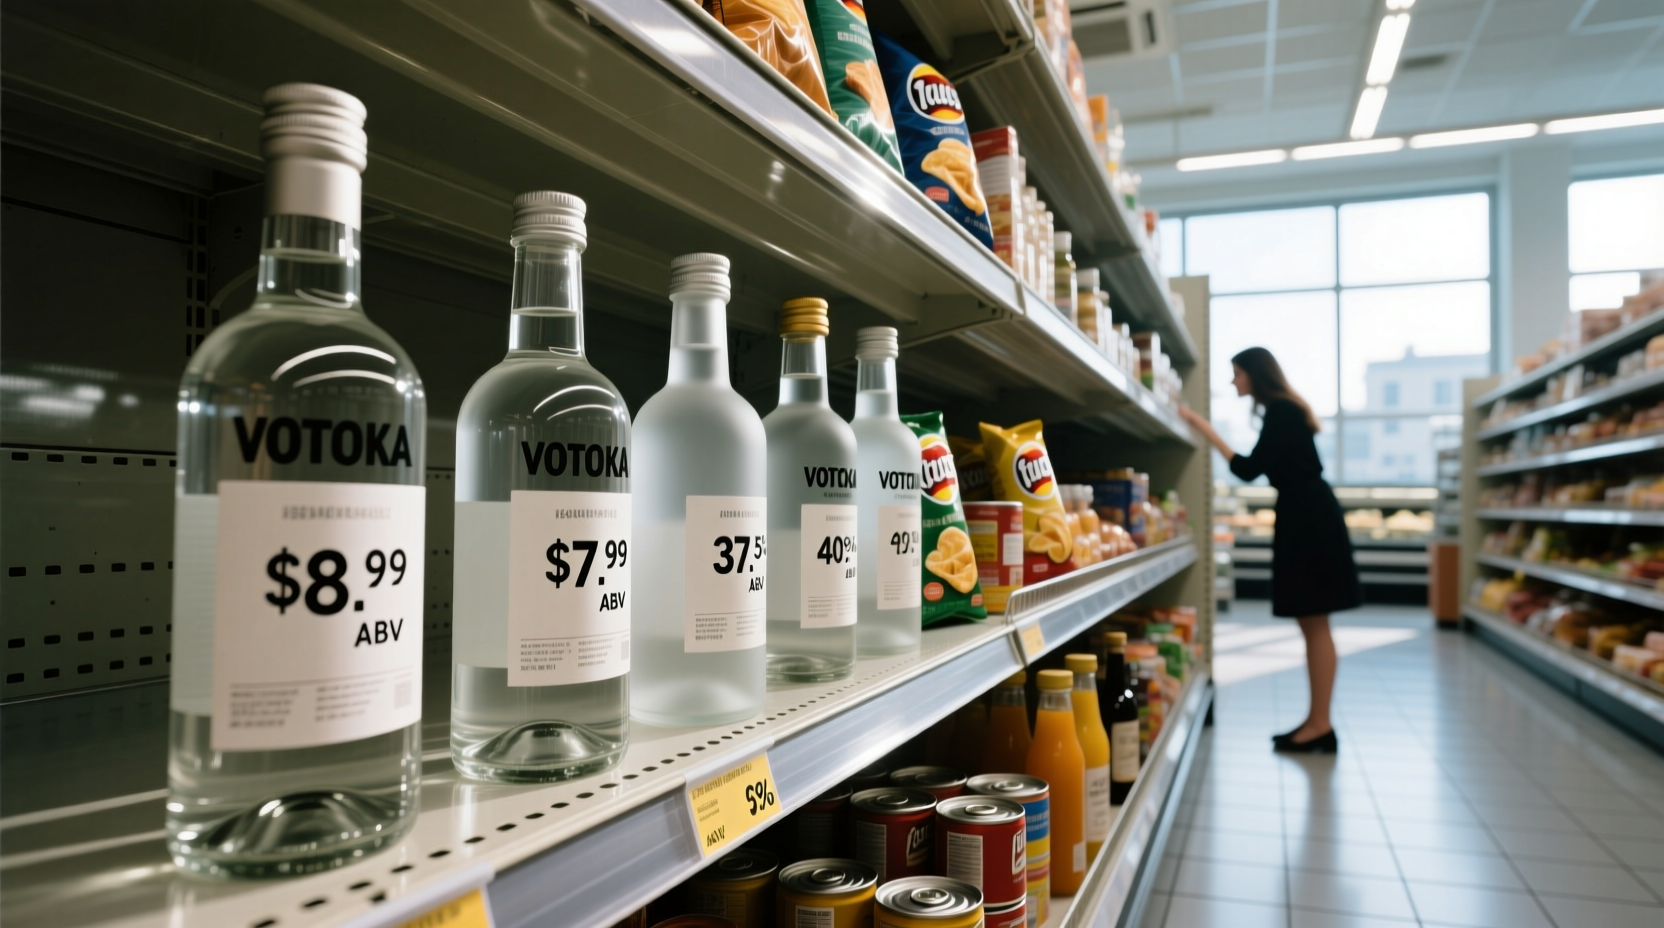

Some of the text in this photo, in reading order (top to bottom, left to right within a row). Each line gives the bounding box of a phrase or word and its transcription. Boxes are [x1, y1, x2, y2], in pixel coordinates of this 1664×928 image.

[233, 416, 412, 467] VOTOKA
[521, 441, 629, 478] VOTOKA
[265, 547, 406, 616] $8.99
[546, 538, 627, 588] $7.99
[600, 591, 626, 612] ABV
[355, 618, 404, 647] ABV
